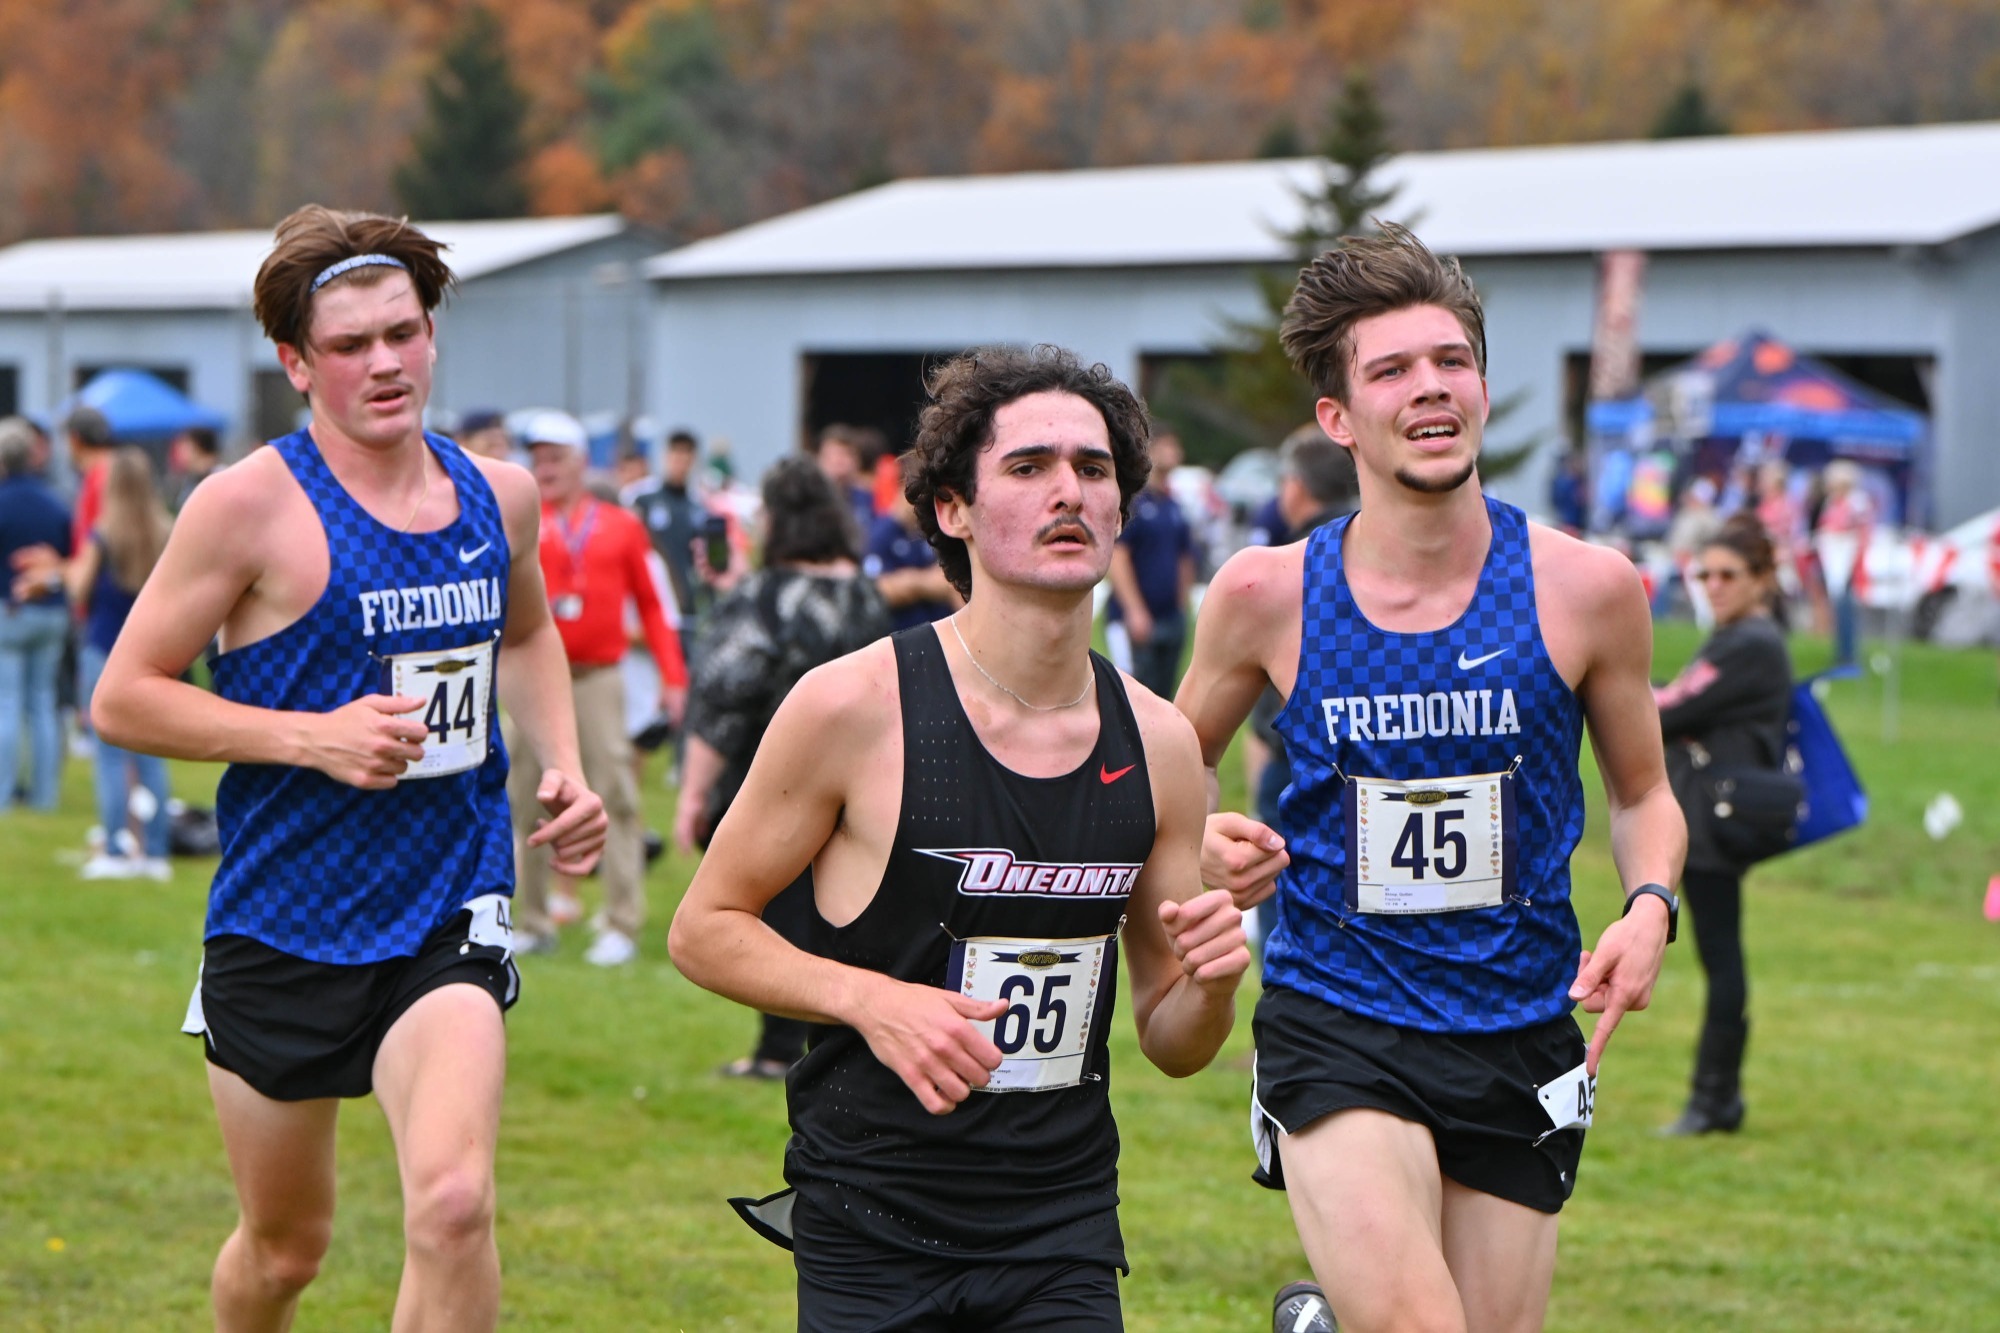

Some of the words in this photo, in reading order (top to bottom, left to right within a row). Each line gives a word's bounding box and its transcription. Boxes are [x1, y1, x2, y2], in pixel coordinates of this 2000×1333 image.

[359, 577, 501, 637] FREDONIA
[424, 676, 476, 744] 44
[1321, 688, 1521, 745] FREDONIA
[1391, 809, 1467, 880] 45
[497, 900, 512, 935] 4
[993, 974, 1072, 1055] 65
